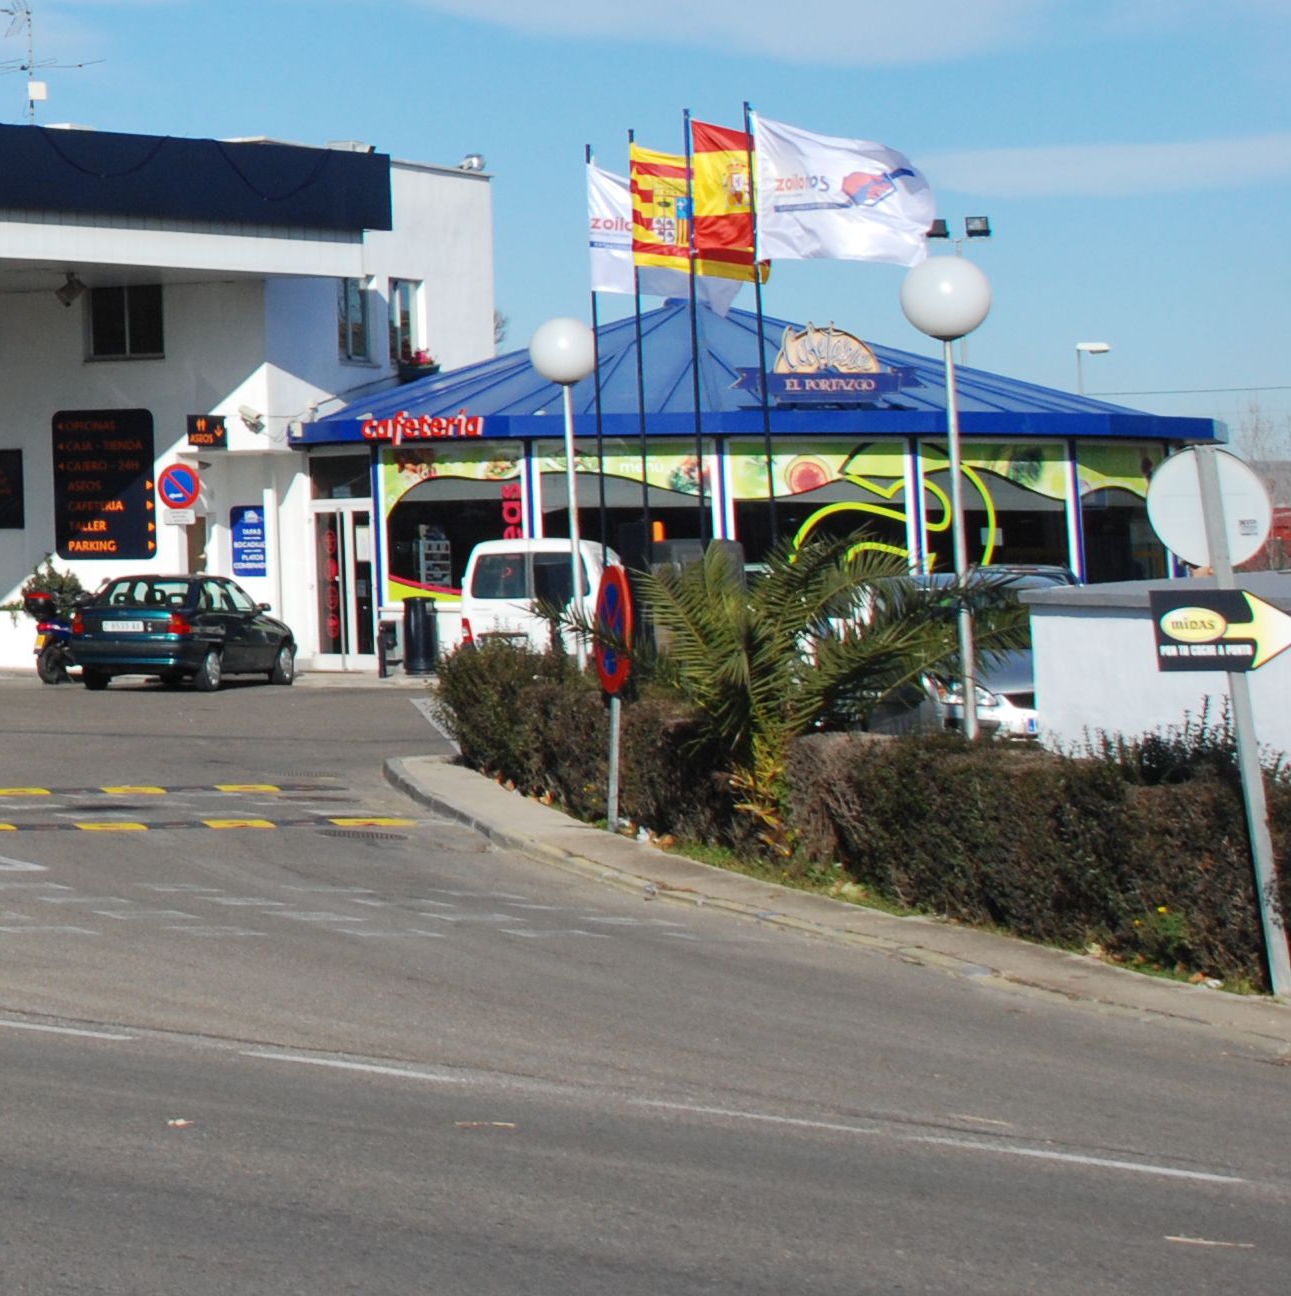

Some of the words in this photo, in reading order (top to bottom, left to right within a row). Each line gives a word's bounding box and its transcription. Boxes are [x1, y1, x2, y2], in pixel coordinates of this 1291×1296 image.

[785, 378, 802, 391] EL
[805, 378, 876, 392] PORTAZGO
[362, 408, 484, 446] cafetería
[189, 433, 214, 444] ASEOS
[70, 520, 107, 532] TALLER
[68, 540, 117, 552] PARKING
